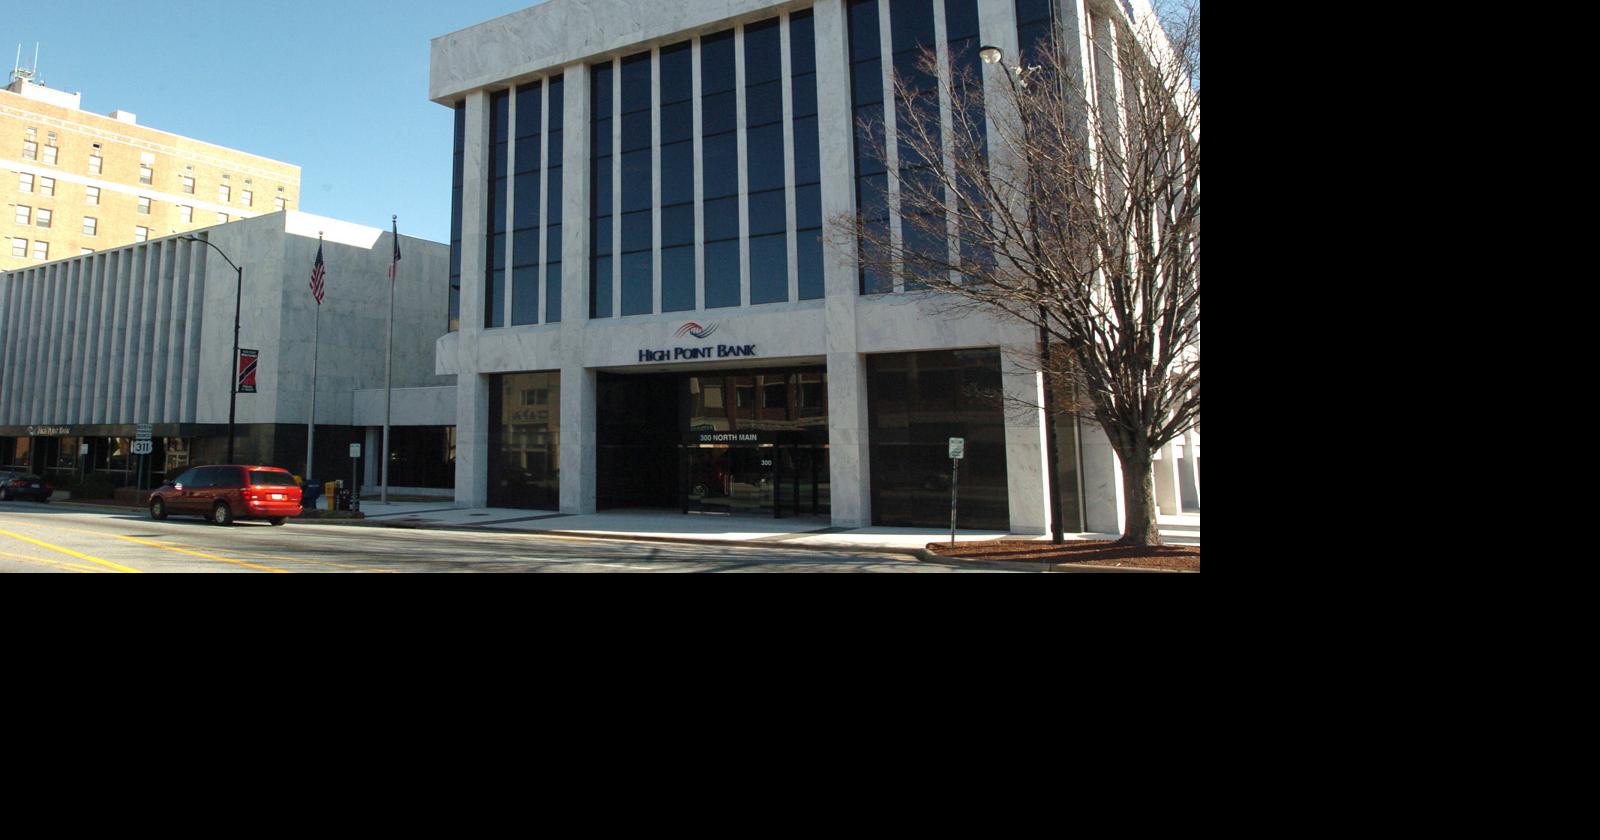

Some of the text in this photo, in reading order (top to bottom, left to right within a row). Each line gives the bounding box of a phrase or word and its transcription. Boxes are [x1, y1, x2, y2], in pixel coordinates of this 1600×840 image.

[717, 344, 756, 358] BANK
[738, 433, 758, 441] MAIN
[136, 442, 149, 452] 311
